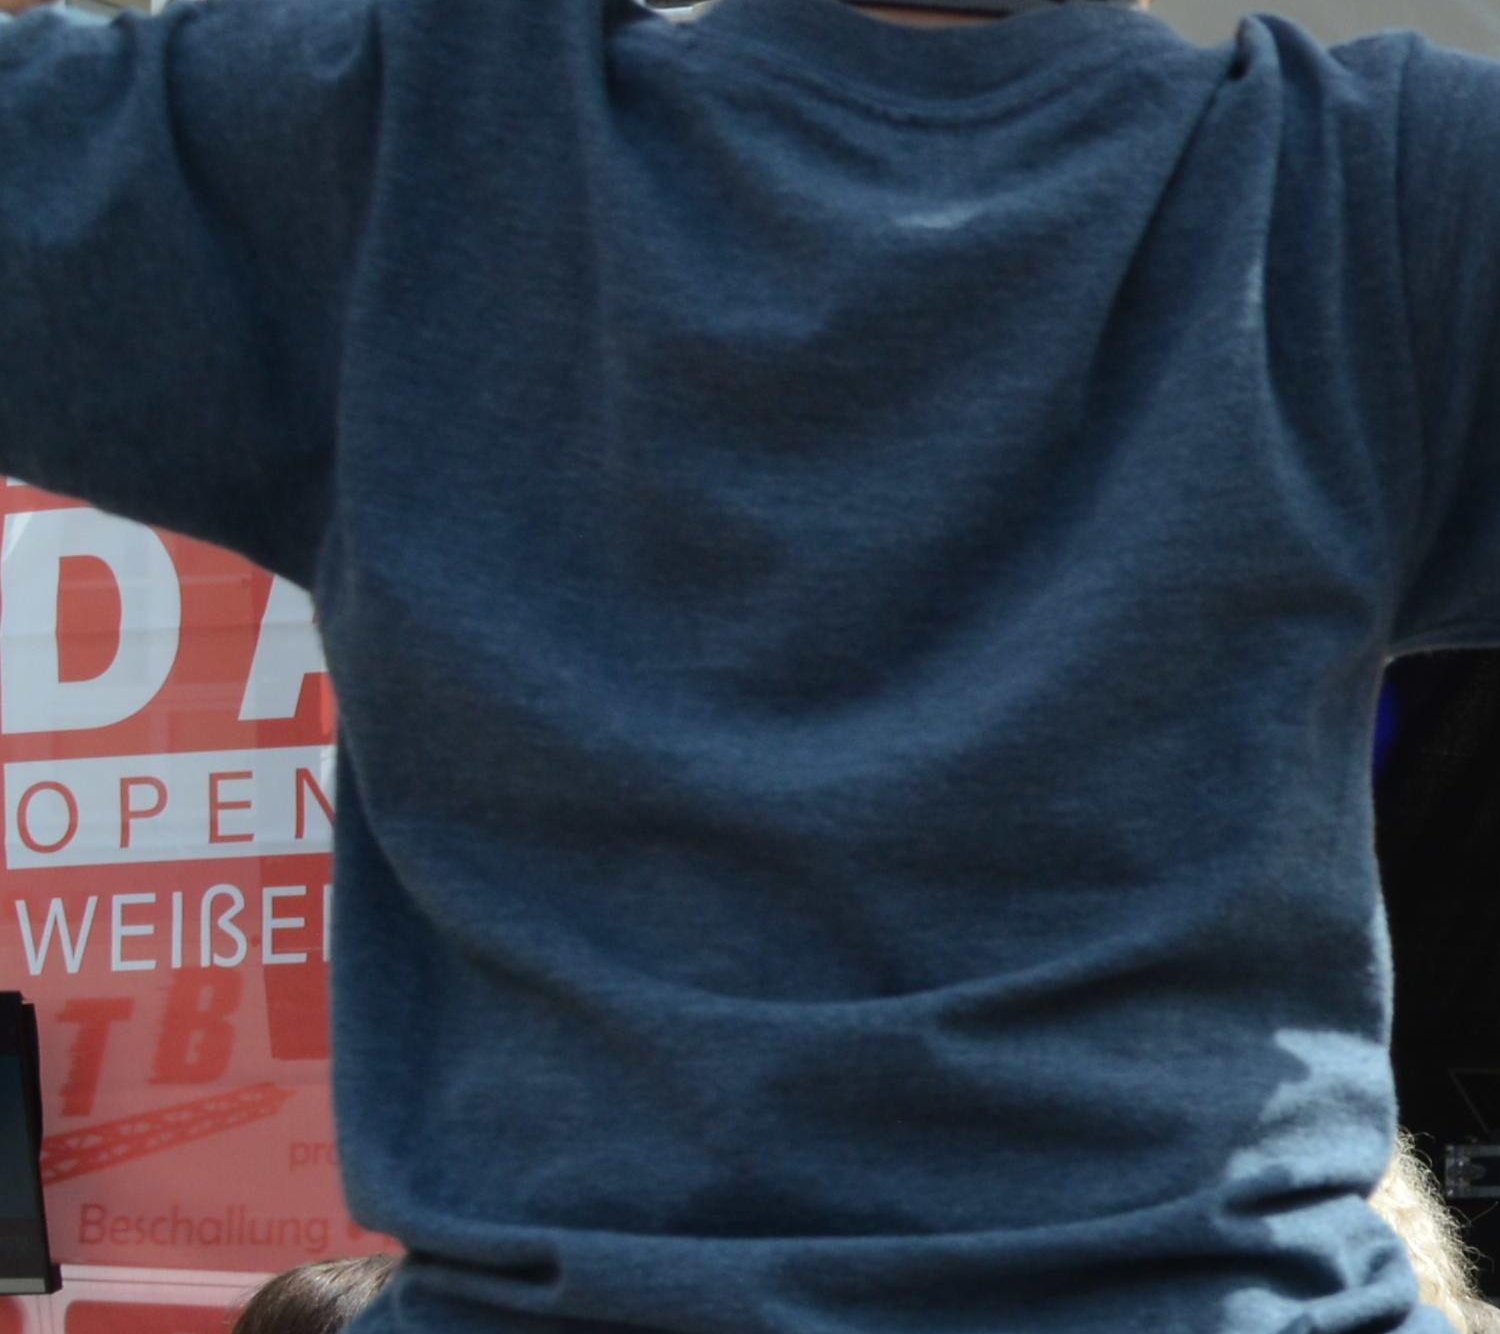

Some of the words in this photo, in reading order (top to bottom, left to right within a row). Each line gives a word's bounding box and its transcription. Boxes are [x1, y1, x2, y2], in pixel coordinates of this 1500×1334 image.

[16, 766, 335, 854] OPEN
[15, 882, 333, 976] WEIßE
[77, 1202, 329, 1254] Beschallung
